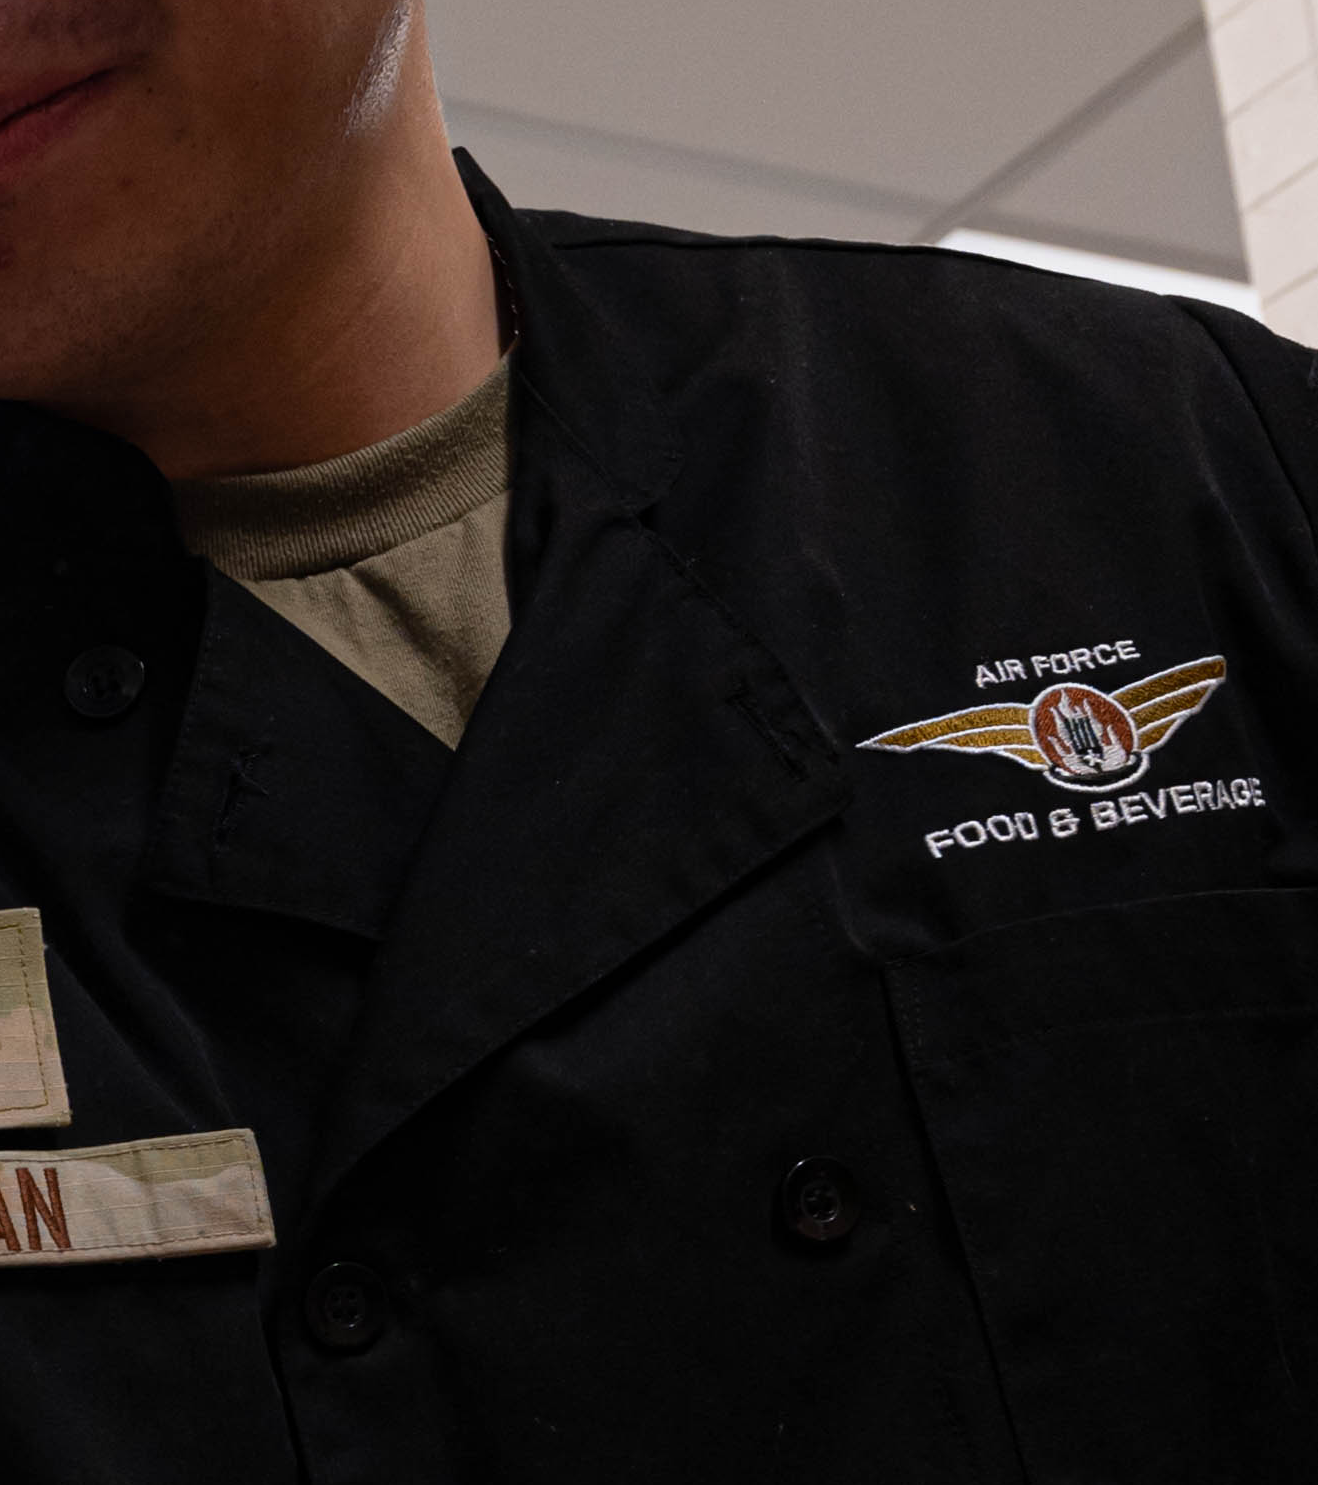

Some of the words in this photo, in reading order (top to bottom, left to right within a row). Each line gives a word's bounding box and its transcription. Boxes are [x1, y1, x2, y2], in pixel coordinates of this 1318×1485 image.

[974, 659, 1028, 689] AIR
[1030, 640, 1142, 679] FORCE
[925, 812, 1040, 859] FOOD
[1050, 808, 1080, 839] &
[1090, 777, 1267, 832] BEVERAGE
